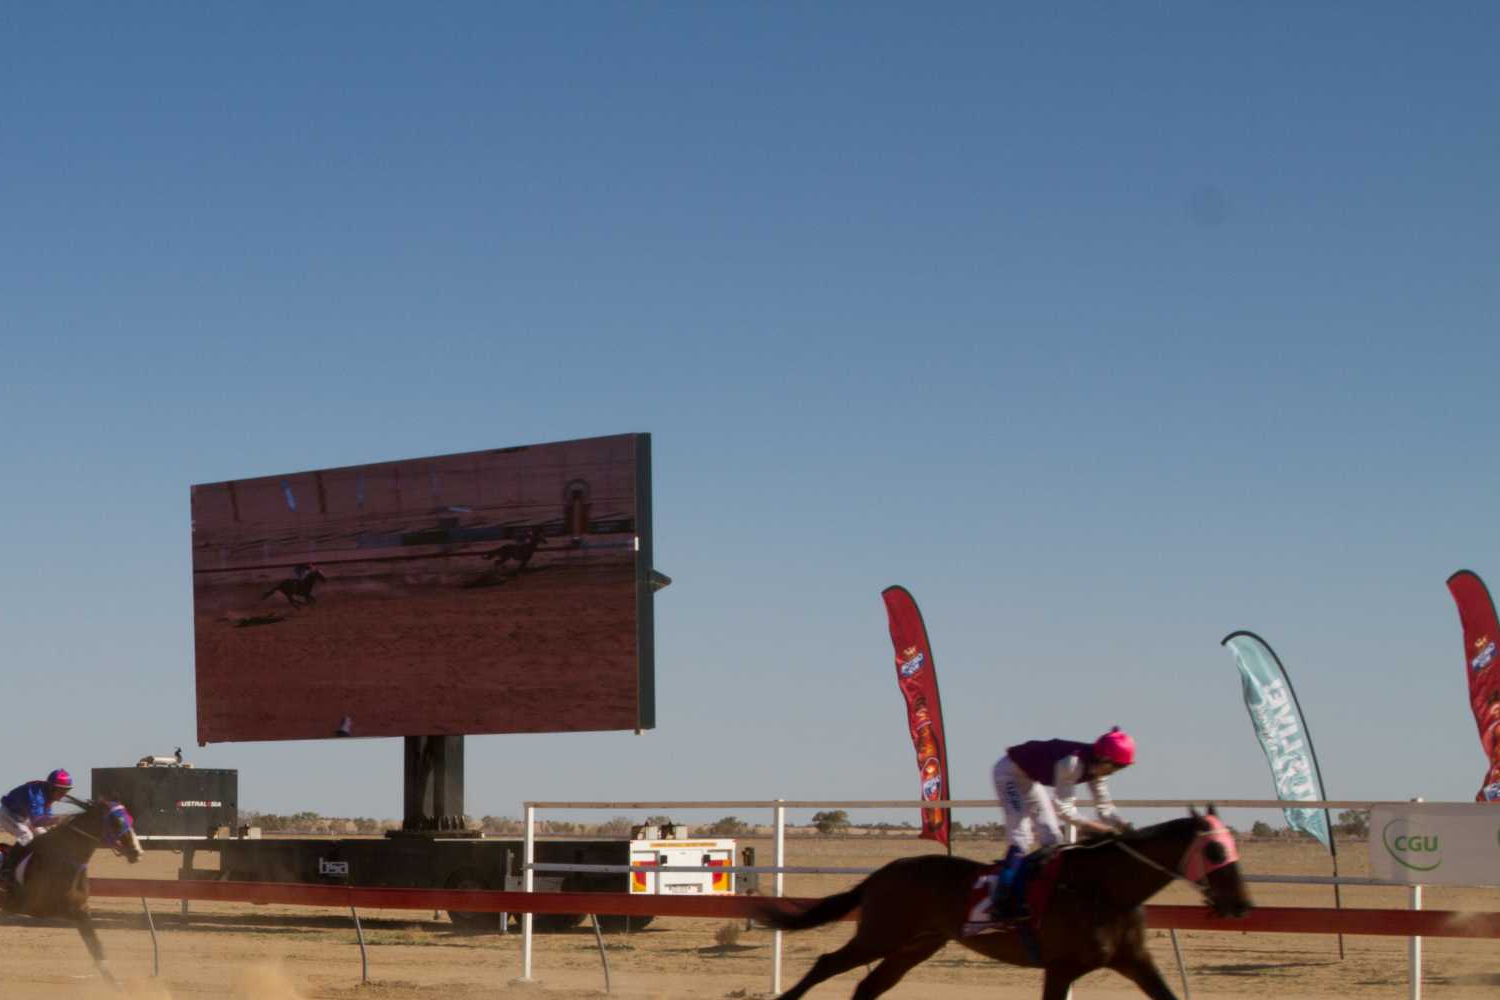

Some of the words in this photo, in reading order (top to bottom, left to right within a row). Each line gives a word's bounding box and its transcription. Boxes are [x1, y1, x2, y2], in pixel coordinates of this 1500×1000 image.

[1394, 835, 1439, 852] CGU
[319, 857, 349, 874] bsa
[969, 875, 1002, 922] 2
